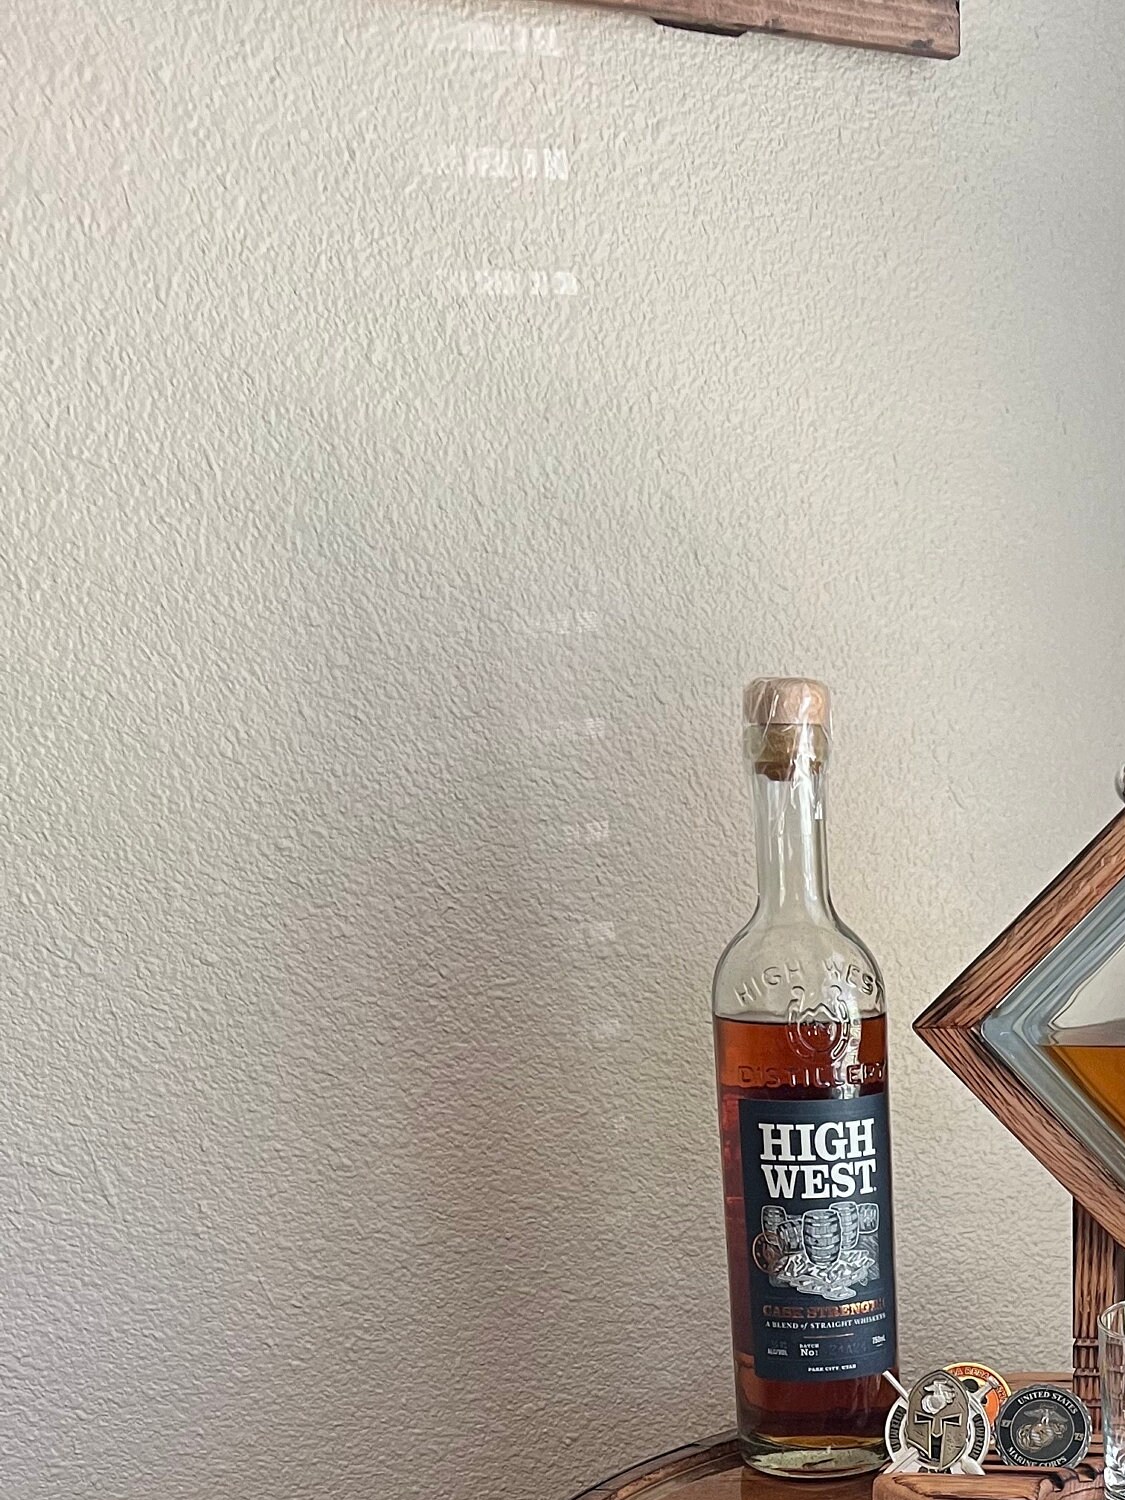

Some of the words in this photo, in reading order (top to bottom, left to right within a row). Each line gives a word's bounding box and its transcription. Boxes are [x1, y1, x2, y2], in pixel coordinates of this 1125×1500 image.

[734, 960, 803, 1006] HIGH
[758, 1117, 876, 1162] HIGH
[761, 1159, 877, 1199] WEST
[772, 1321, 799, 1329] BLEND
[800, 1322, 808, 1331] of
[810, 1319, 852, 1329] STRAIGHT
[854, 1312, 886, 1325] WHISKEYS
[1017, 1390, 1050, 1405] UNITED
[1051, 1391, 1079, 1415] STATES
[1007, 1446, 1038, 1467] MARINE
